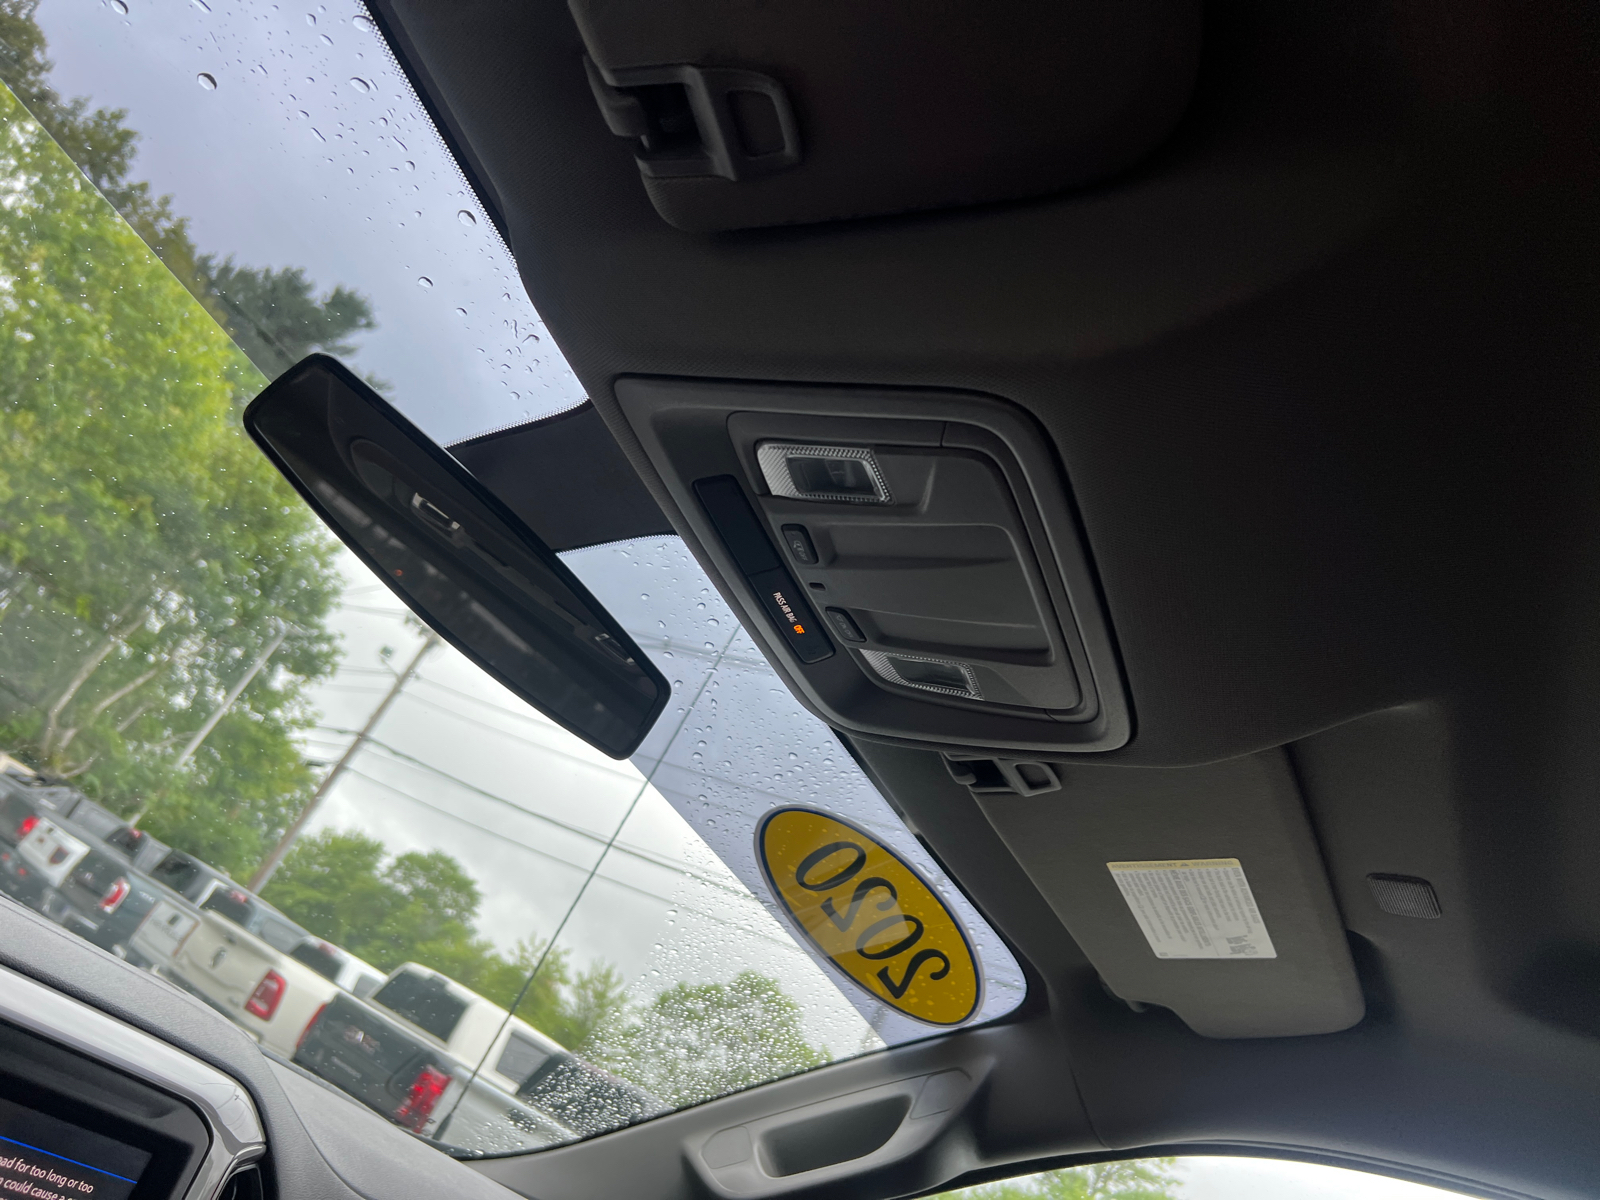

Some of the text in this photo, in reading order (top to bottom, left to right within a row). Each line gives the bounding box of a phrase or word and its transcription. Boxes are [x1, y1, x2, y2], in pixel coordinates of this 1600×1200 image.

[773, 592, 805, 634] PASS AIR BAG OFF
[3, 1179, 34, 1194] could
[30, 1187, 58, 1200] cause
[14, 1159, 30, 1173] for
[30, 1165, 46, 1178] too
[46, 1169, 67, 1188] long
[67, 1179, 79, 1188] or
[78, 1181, 94, 1193] too
